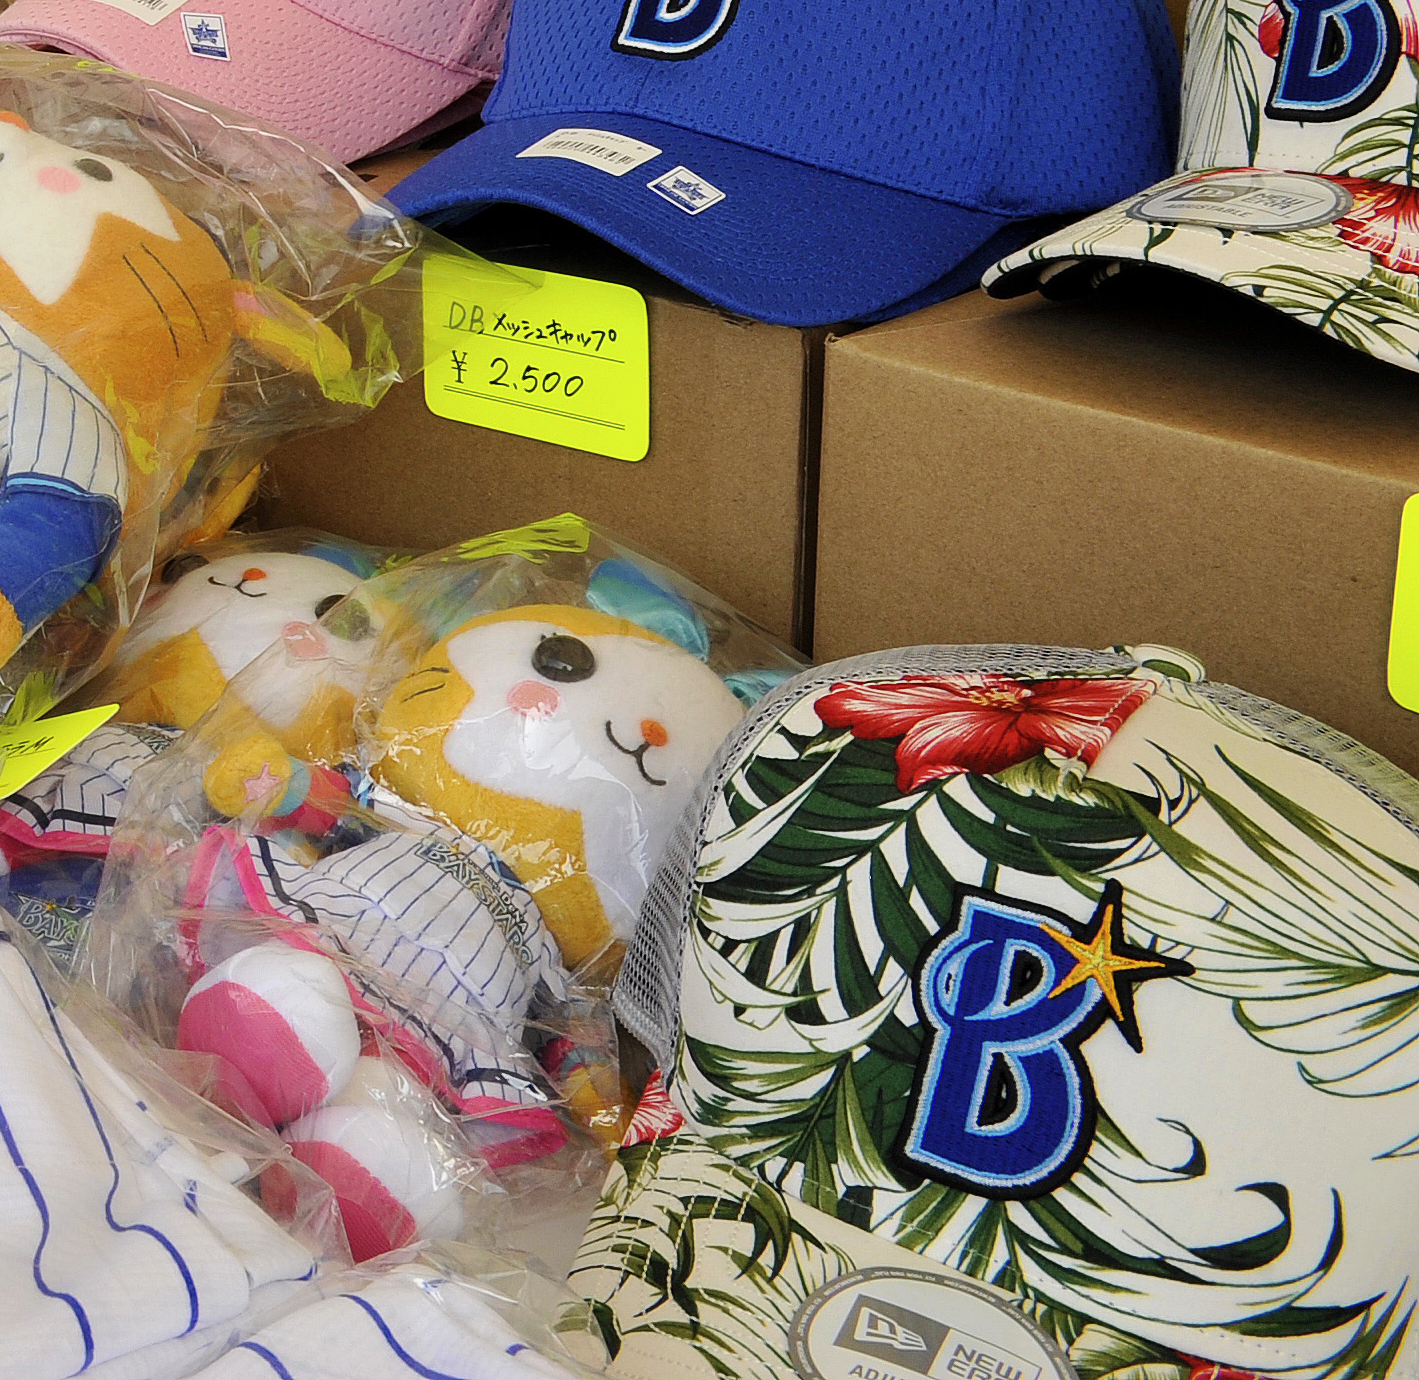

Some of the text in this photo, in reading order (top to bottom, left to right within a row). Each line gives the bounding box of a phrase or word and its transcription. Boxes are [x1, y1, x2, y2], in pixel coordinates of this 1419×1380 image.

[449, 298, 618, 352] DB メッシュキャップ
[896, 882, 1100, 1200] B
[952, 1343, 1023, 1380] NEW
